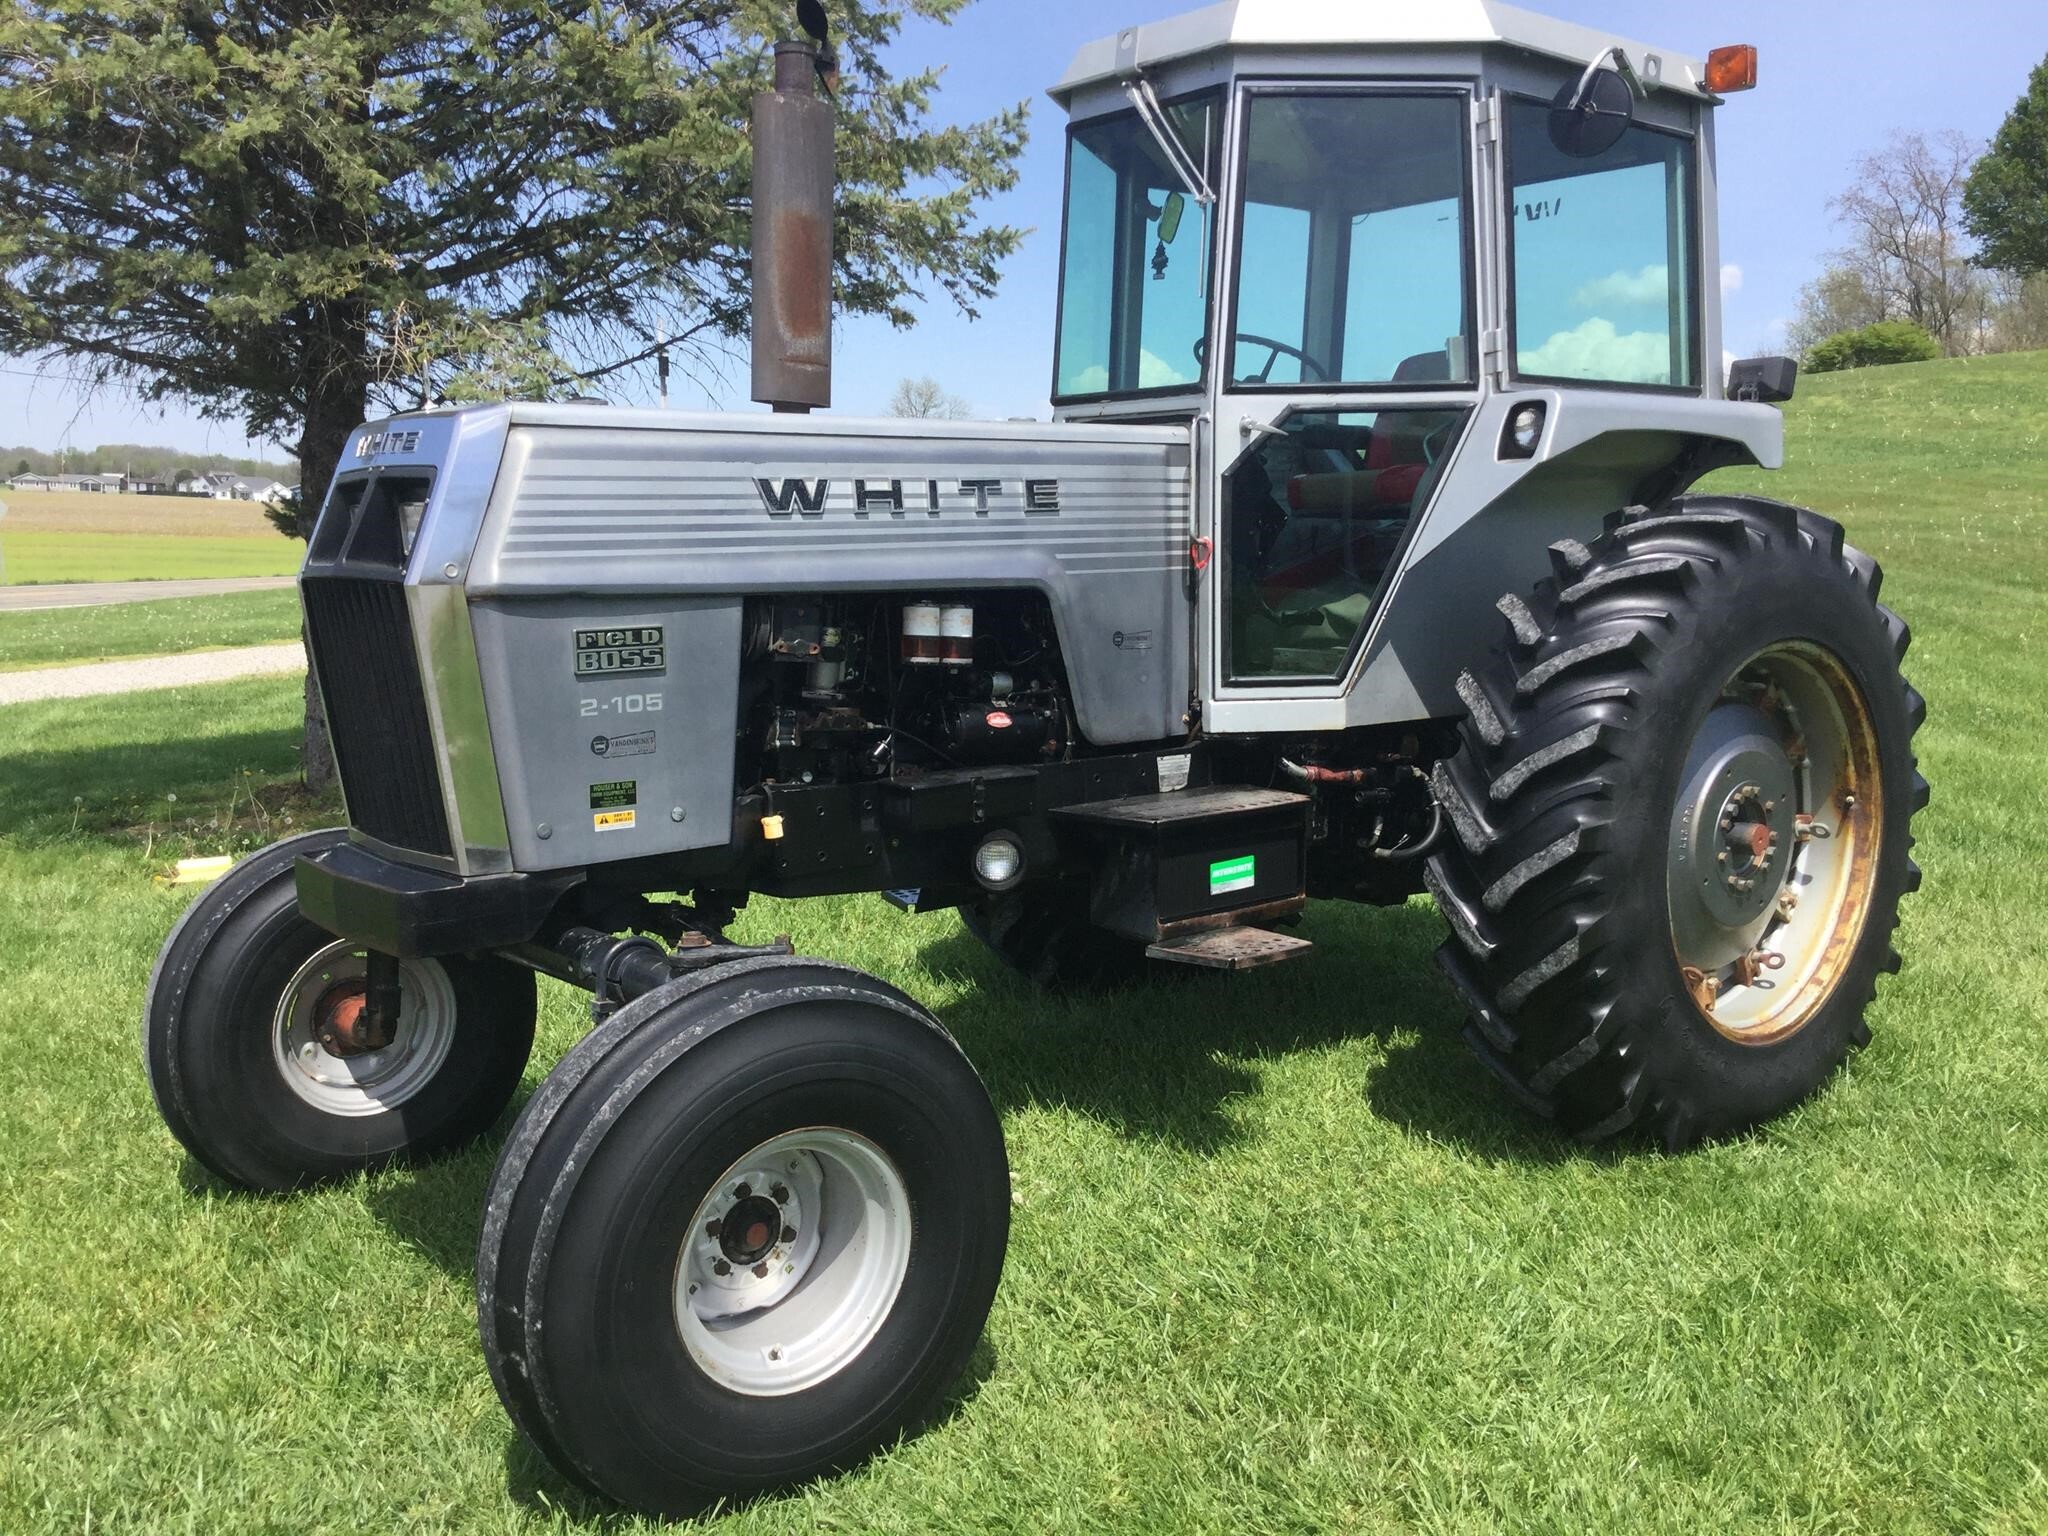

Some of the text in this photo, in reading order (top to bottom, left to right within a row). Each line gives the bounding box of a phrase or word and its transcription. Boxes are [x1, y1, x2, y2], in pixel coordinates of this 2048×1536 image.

[356, 430, 422, 457] WHITE
[751, 476, 1060, 516] WHITE
[578, 648, 663, 671] BOSS
[580, 693, 663, 717] 2-105
